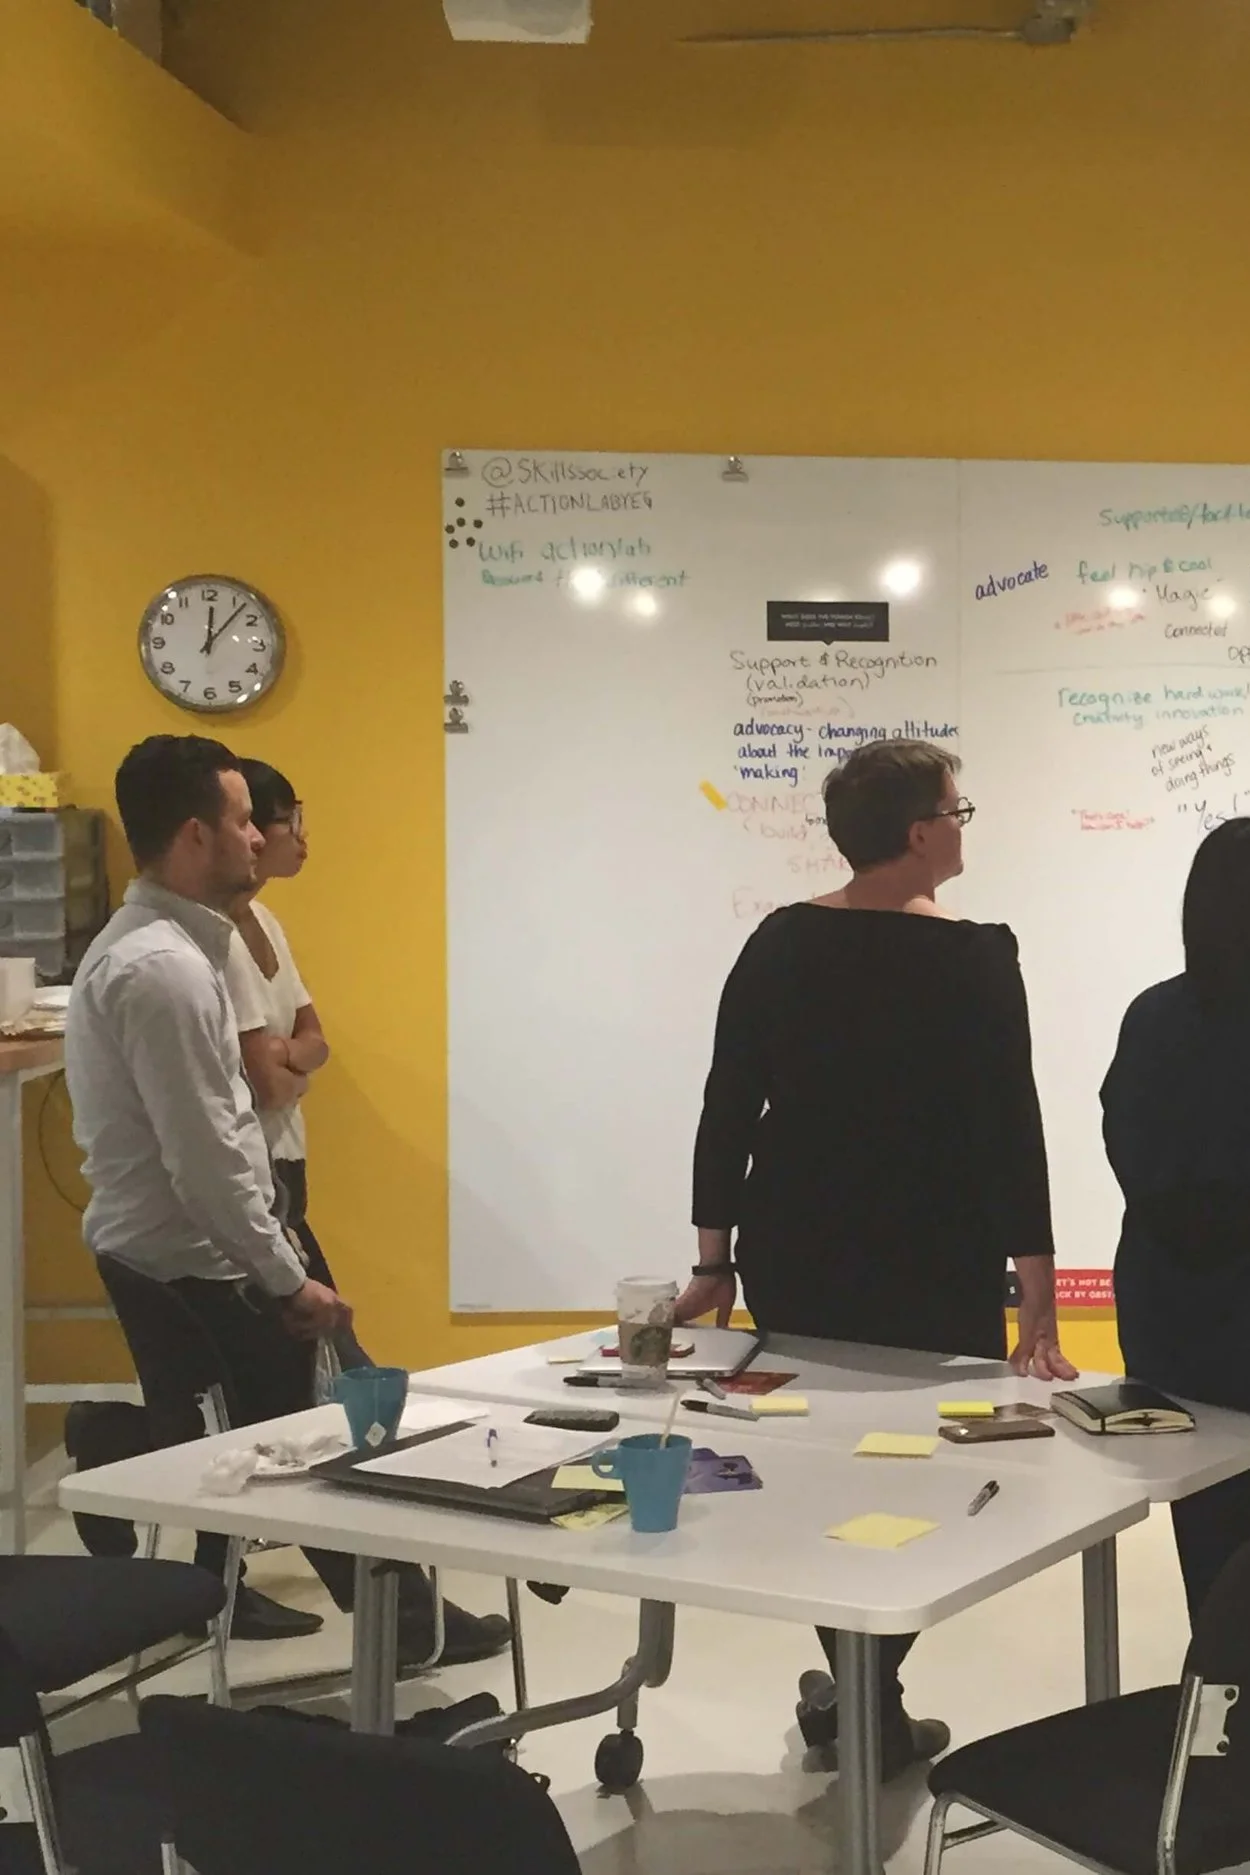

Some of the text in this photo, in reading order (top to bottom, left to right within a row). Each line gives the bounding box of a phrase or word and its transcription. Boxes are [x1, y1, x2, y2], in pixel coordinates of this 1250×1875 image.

[1178, 556, 1212, 573] cool
[975, 559, 1049, 601] advocate
[202, 589, 218, 601] 12
[160, 613, 258, 627] 10 2
[152, 637, 166, 649] 9
[160, 661, 258, 674] 8 4
[730, 650, 811, 675] Support
[835, 650, 938, 679] Recognition
[179, 680, 242, 700] 7 6 5
[818, 720, 887, 745] changing
[737, 744, 777, 760] about
[787, 743, 811, 760] the
[1056, 1278, 1112, 1287] ET'S NOT BE
[1074, 1291, 1086, 1299] BY
